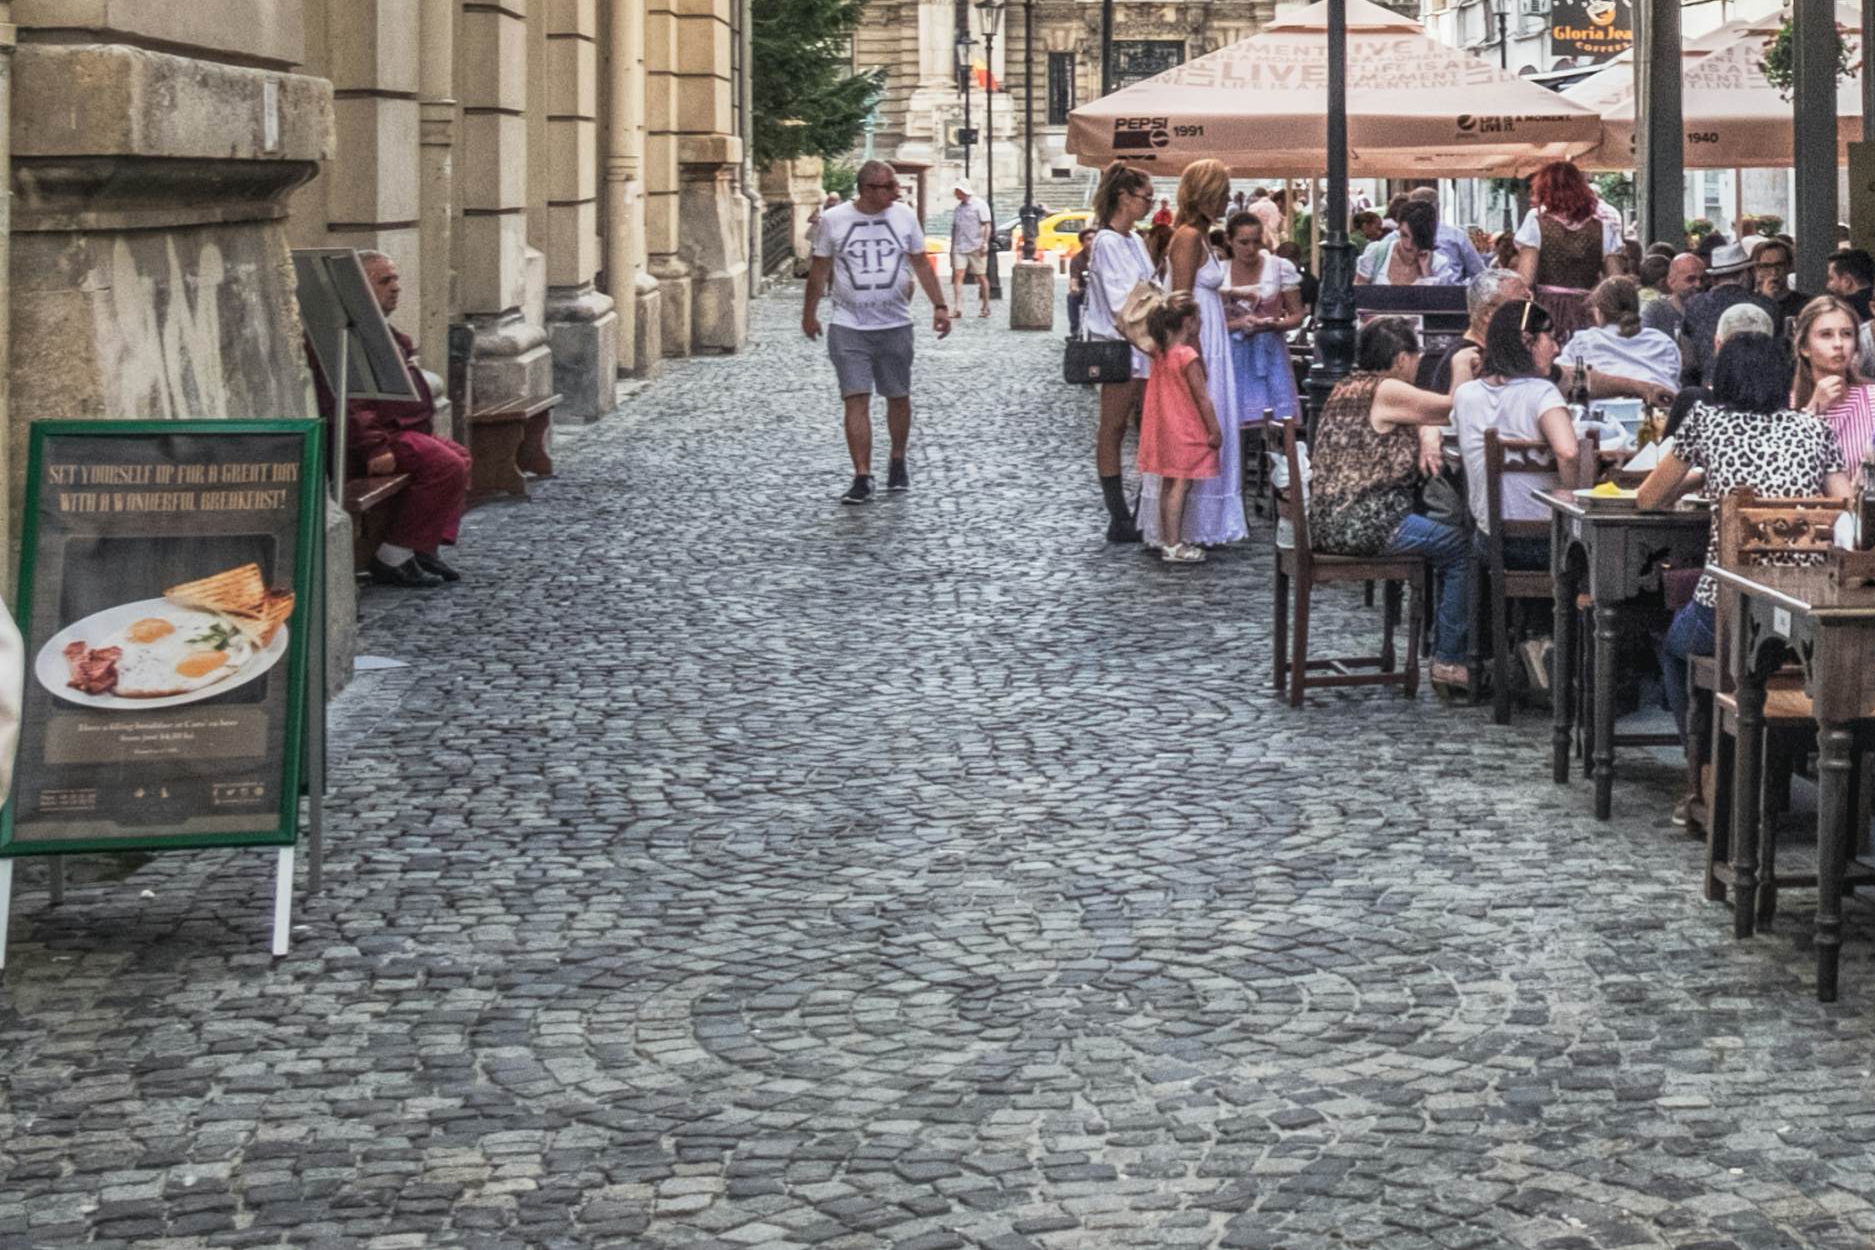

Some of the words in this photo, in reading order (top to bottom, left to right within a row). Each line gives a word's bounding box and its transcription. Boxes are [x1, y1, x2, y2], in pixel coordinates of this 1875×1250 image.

[1553, 26, 1604, 41] Gloria
[1607, 26, 1633, 41] Jea
[1222, 62, 1326, 82] LIVE
[1684, 72, 1742, 82] MENT
[1115, 117, 1169, 130] PEPSI
[1173, 125, 1204, 137] 1991
[1687, 132, 1718, 144] 1940
[49, 464, 76, 485] SET
[80, 464, 152, 485] YOURSELF
[155, 464, 175, 484] UP
[177, 463, 205, 484] FOR
[208, 463, 218, 483] A
[221, 462, 271, 483] GREAT
[272, 461, 299, 482] DAY
[60, 492, 97, 512] WITH
[99, 492, 110, 512] A
[113, 491, 196, 512] WONDERFUL
[200, 489, 287, 511] BREAKFAST!
